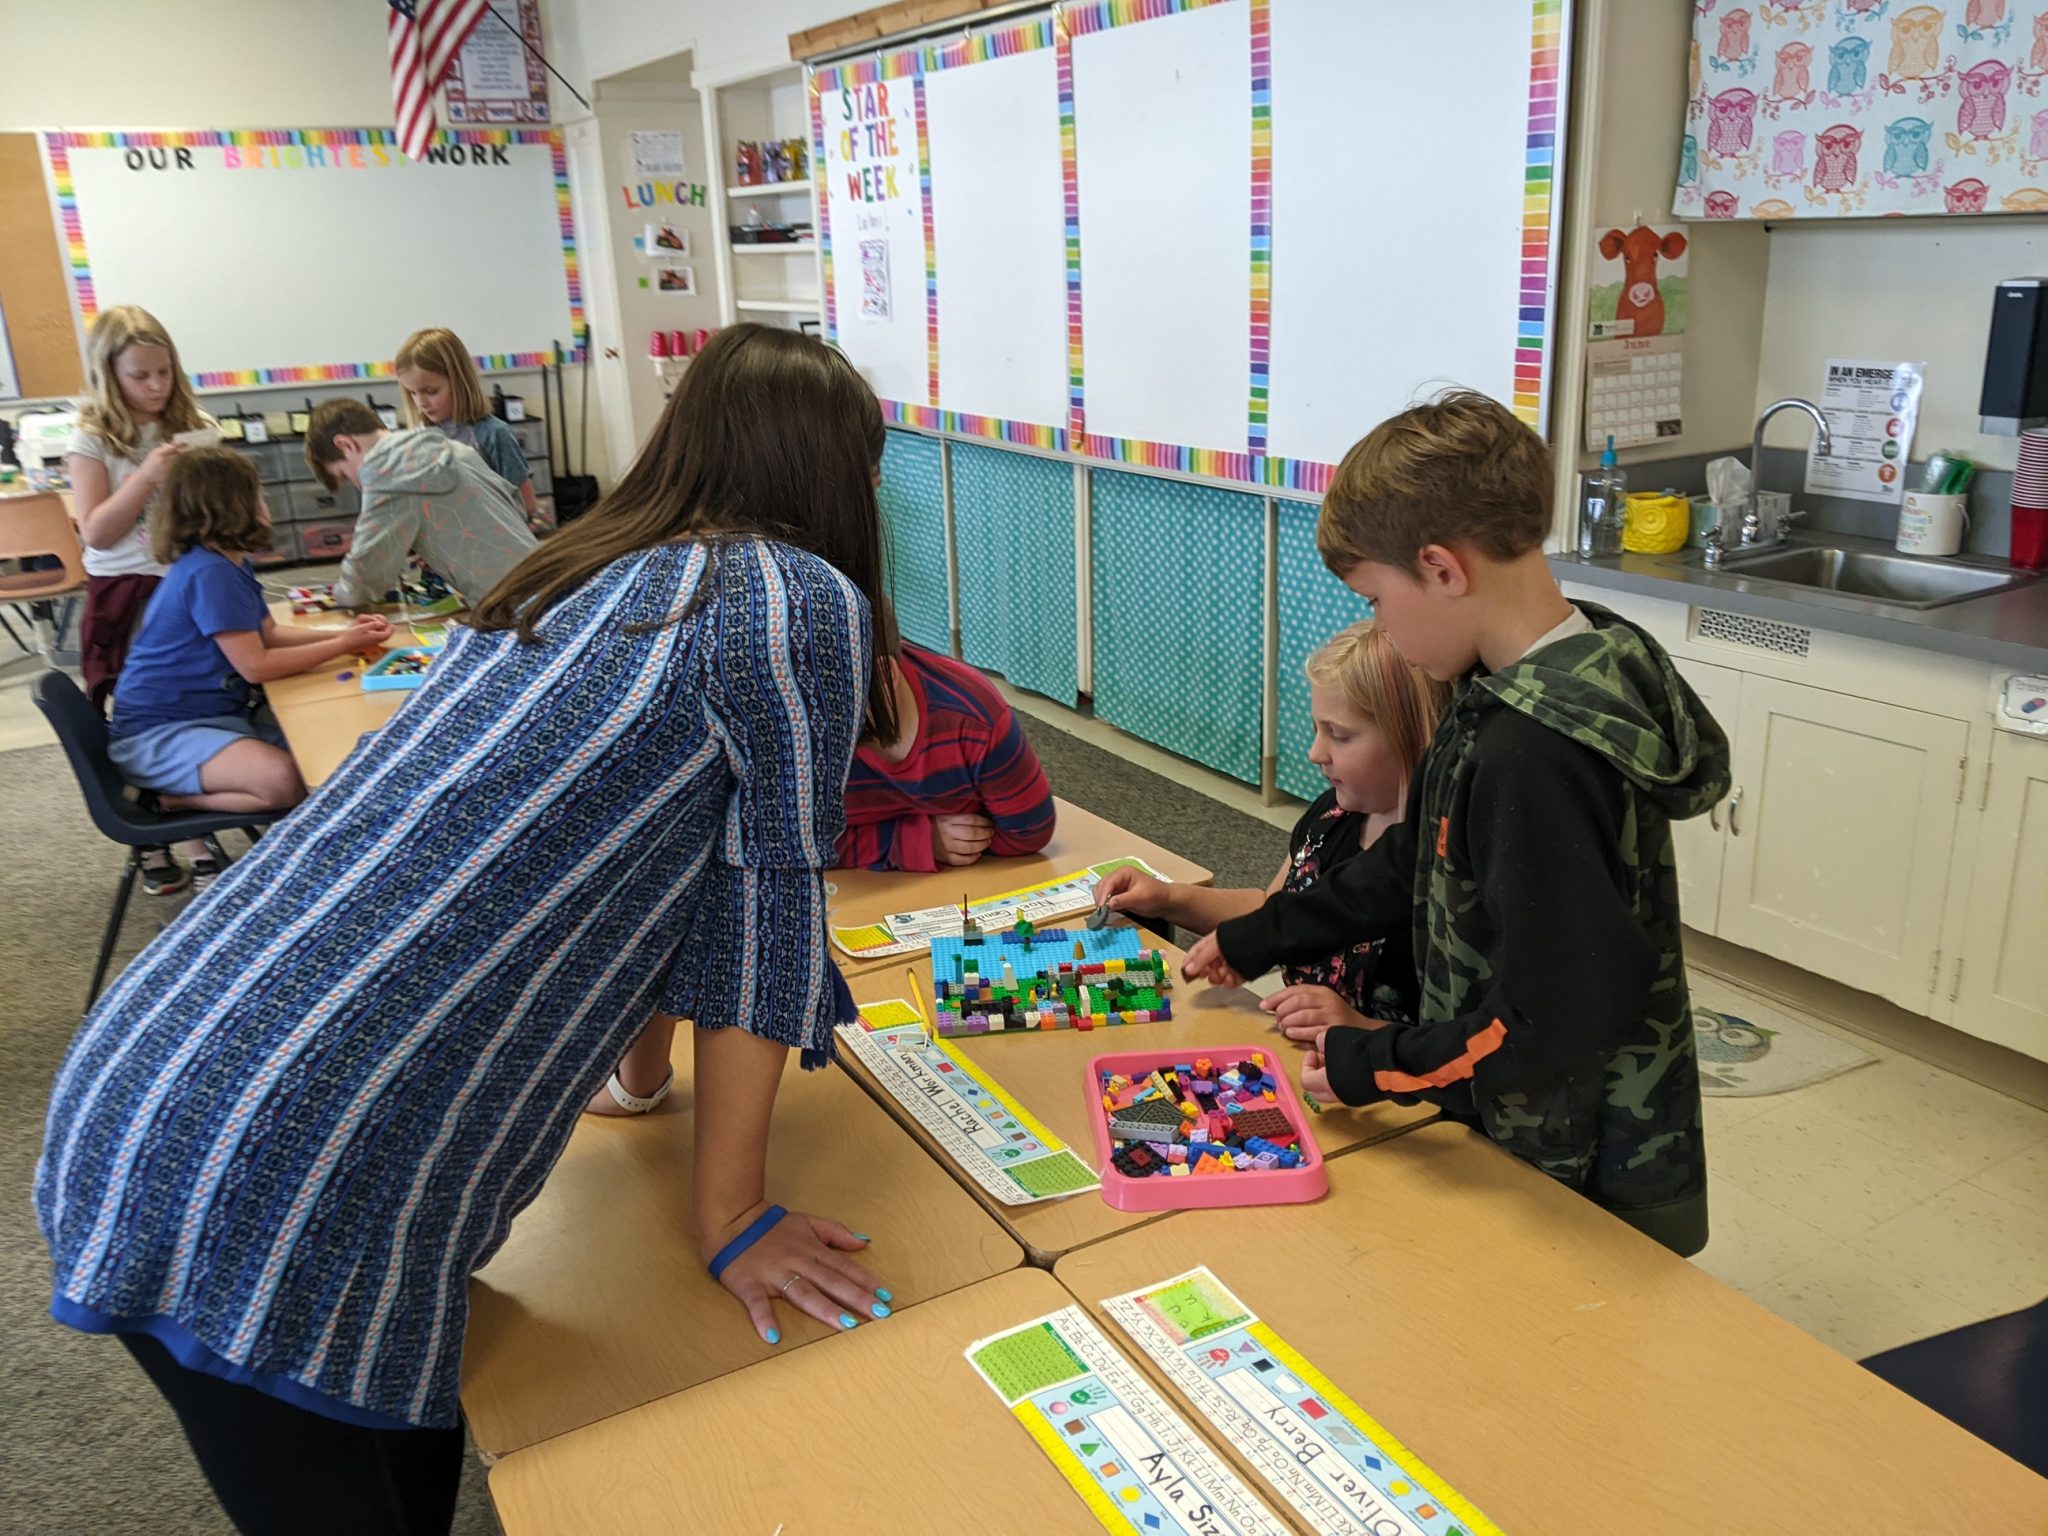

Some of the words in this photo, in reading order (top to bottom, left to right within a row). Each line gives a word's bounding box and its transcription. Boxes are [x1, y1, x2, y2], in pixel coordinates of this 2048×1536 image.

[842, 82, 889, 122] STAR
[841, 126, 860, 162] OF
[865, 118, 899, 157] THE
[126, 146, 196, 171] OUR
[427, 141, 511, 166] WORK
[847, 164, 899, 203] WEEK
[621, 180, 707, 209] LUNCH
[1829, 366, 1839, 376] IN
[1841, 367, 1854, 377] AN
[899, 1052, 945, 1097] Workman
[942, 1099, 983, 1135] Rachel
[1055, 1314, 1072, 1331] Aa
[1069, 1329, 1085, 1344] Bb
[1080, 1341, 1097, 1358] Cc
[1092, 1357, 1109, 1371] Dd
[1105, 1369, 1120, 1383] Ee
[1117, 1381, 1136, 1399] Ff
[1127, 1395, 1148, 1416] Gg
[1143, 1409, 1162, 1427] Hh
[1157, 1424, 1172, 1438] Ii
[1264, 1407, 1325, 1465] Berry
[1163, 1435, 1184, 1456] Jj
[1178, 1448, 1197, 1466] Kk
[1192, 1464, 1210, 1480] Ll
[1139, 1453, 1184, 1503] Ayla
[1188, 1504, 1225, 1536] Siz
[1204, 1477, 1228, 1501] Mm
[1223, 1497, 1243, 1517] Nn
[1329, 1473, 1401, 1536] Oliver
[1239, 1513, 1260, 1536] Oo
